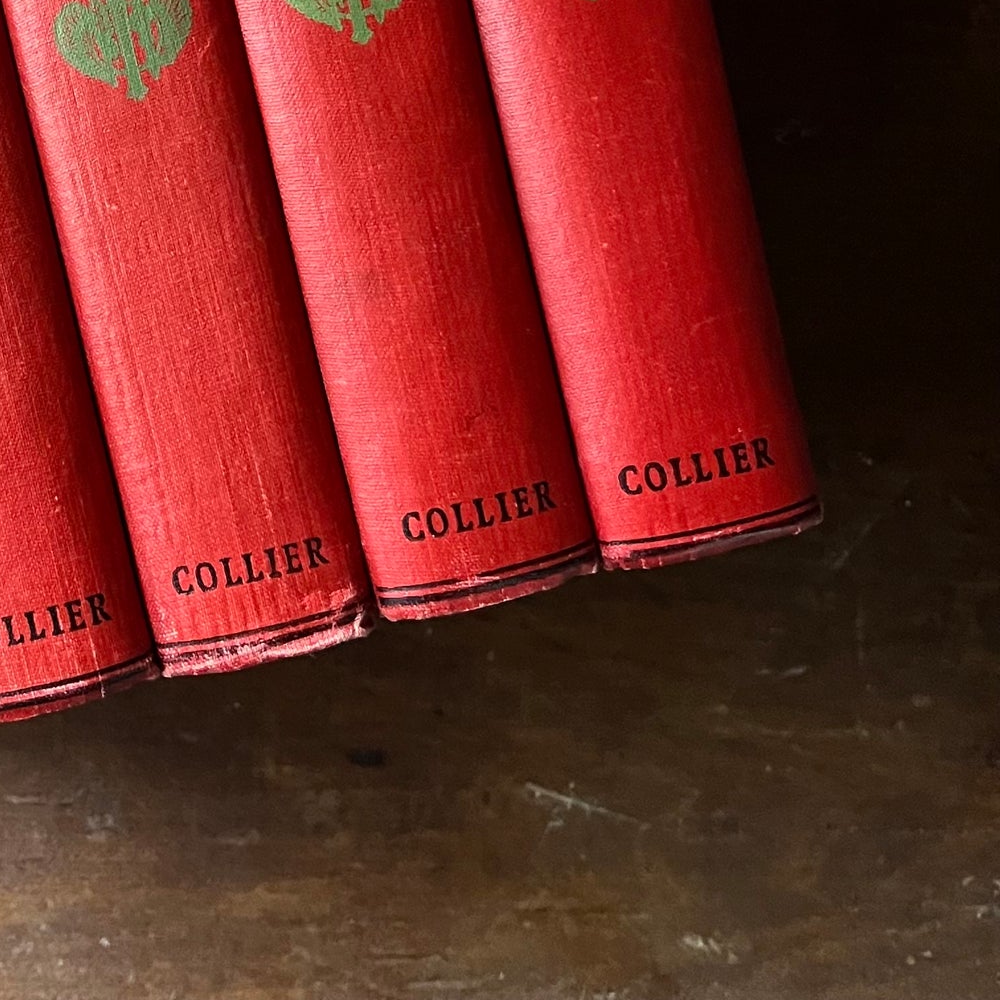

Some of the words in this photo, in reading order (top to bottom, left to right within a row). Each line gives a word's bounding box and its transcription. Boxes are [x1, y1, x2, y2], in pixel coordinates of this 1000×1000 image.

[618, 437, 775, 495] COLLIER
[402, 481, 557, 541] COLLIER
[172, 537, 330, 595] COLLIER
